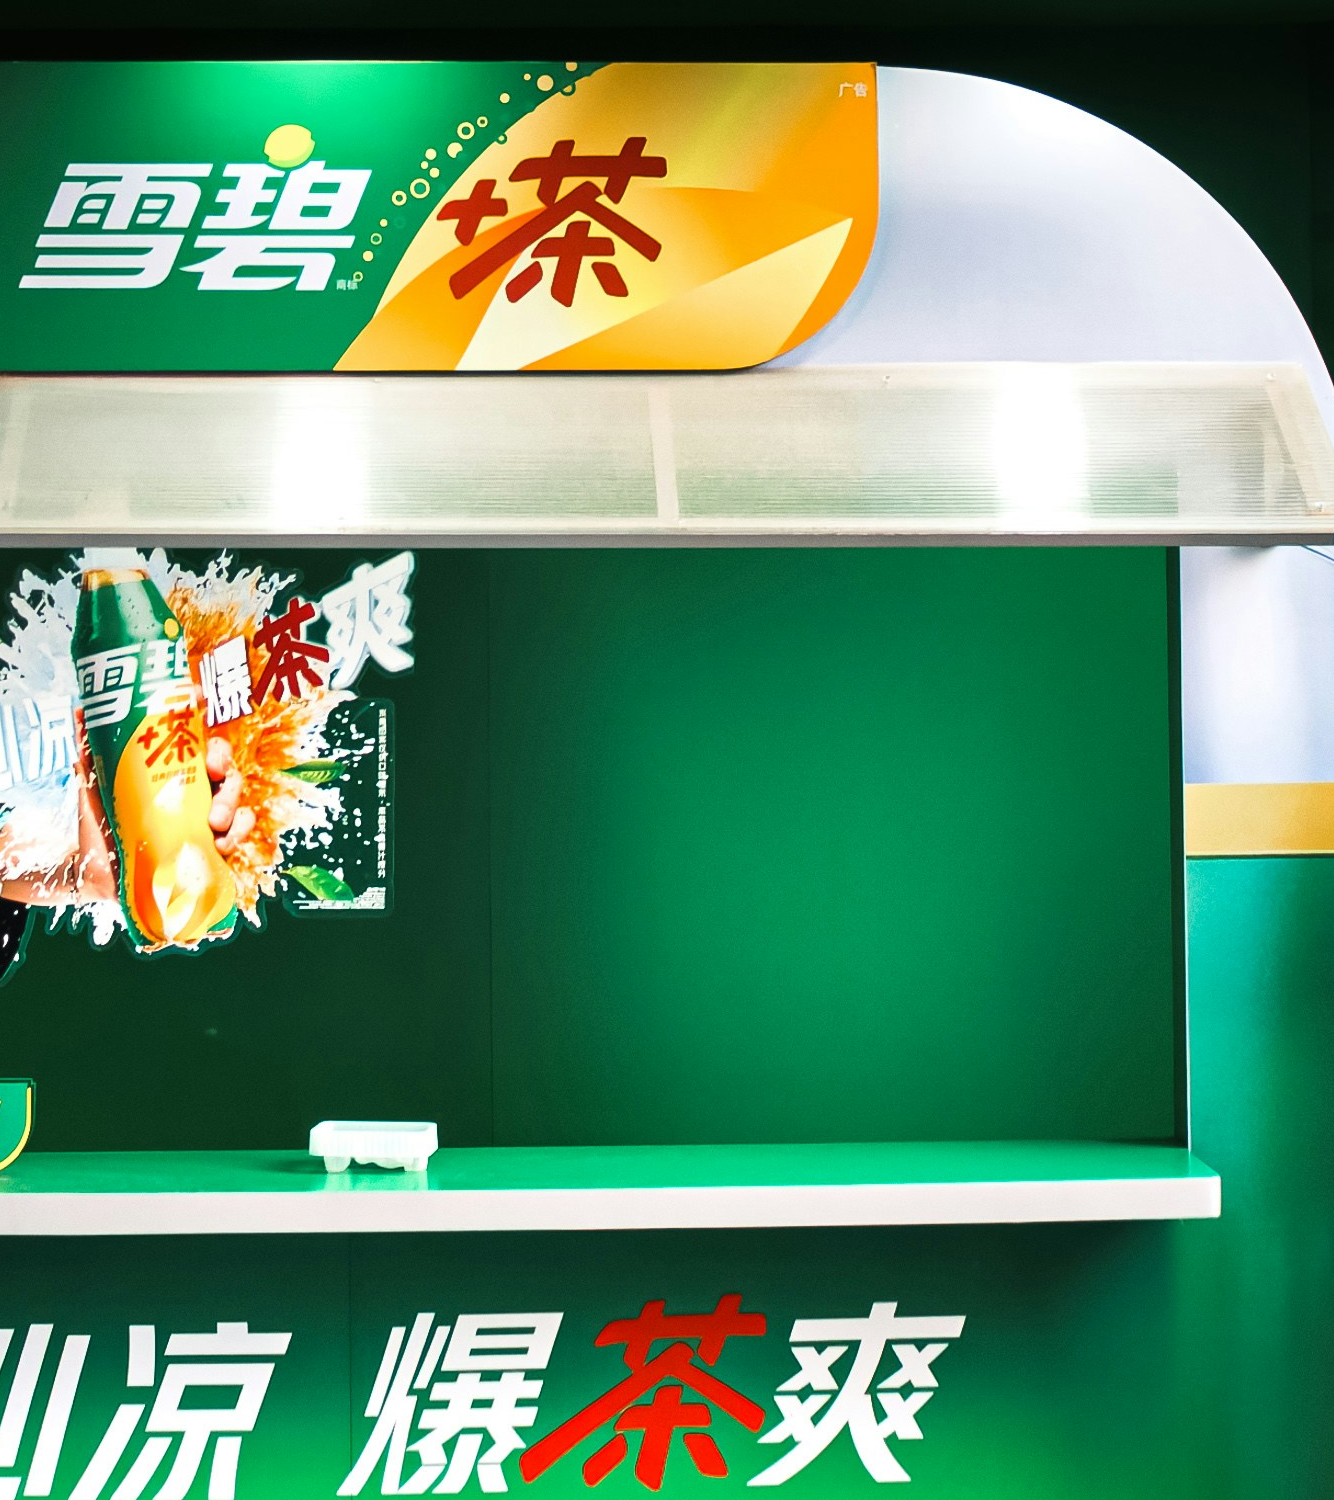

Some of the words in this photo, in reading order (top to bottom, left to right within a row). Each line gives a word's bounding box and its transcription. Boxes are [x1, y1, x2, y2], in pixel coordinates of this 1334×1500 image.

[838, 81, 869, 98] 广告
[19, 163, 373, 292] 雪碧
[76, 638, 198, 730] 雪碧
[198, 551, 415, 727] 爆茶爽
[335, 1292, 967, 1492] 爆茶爽
